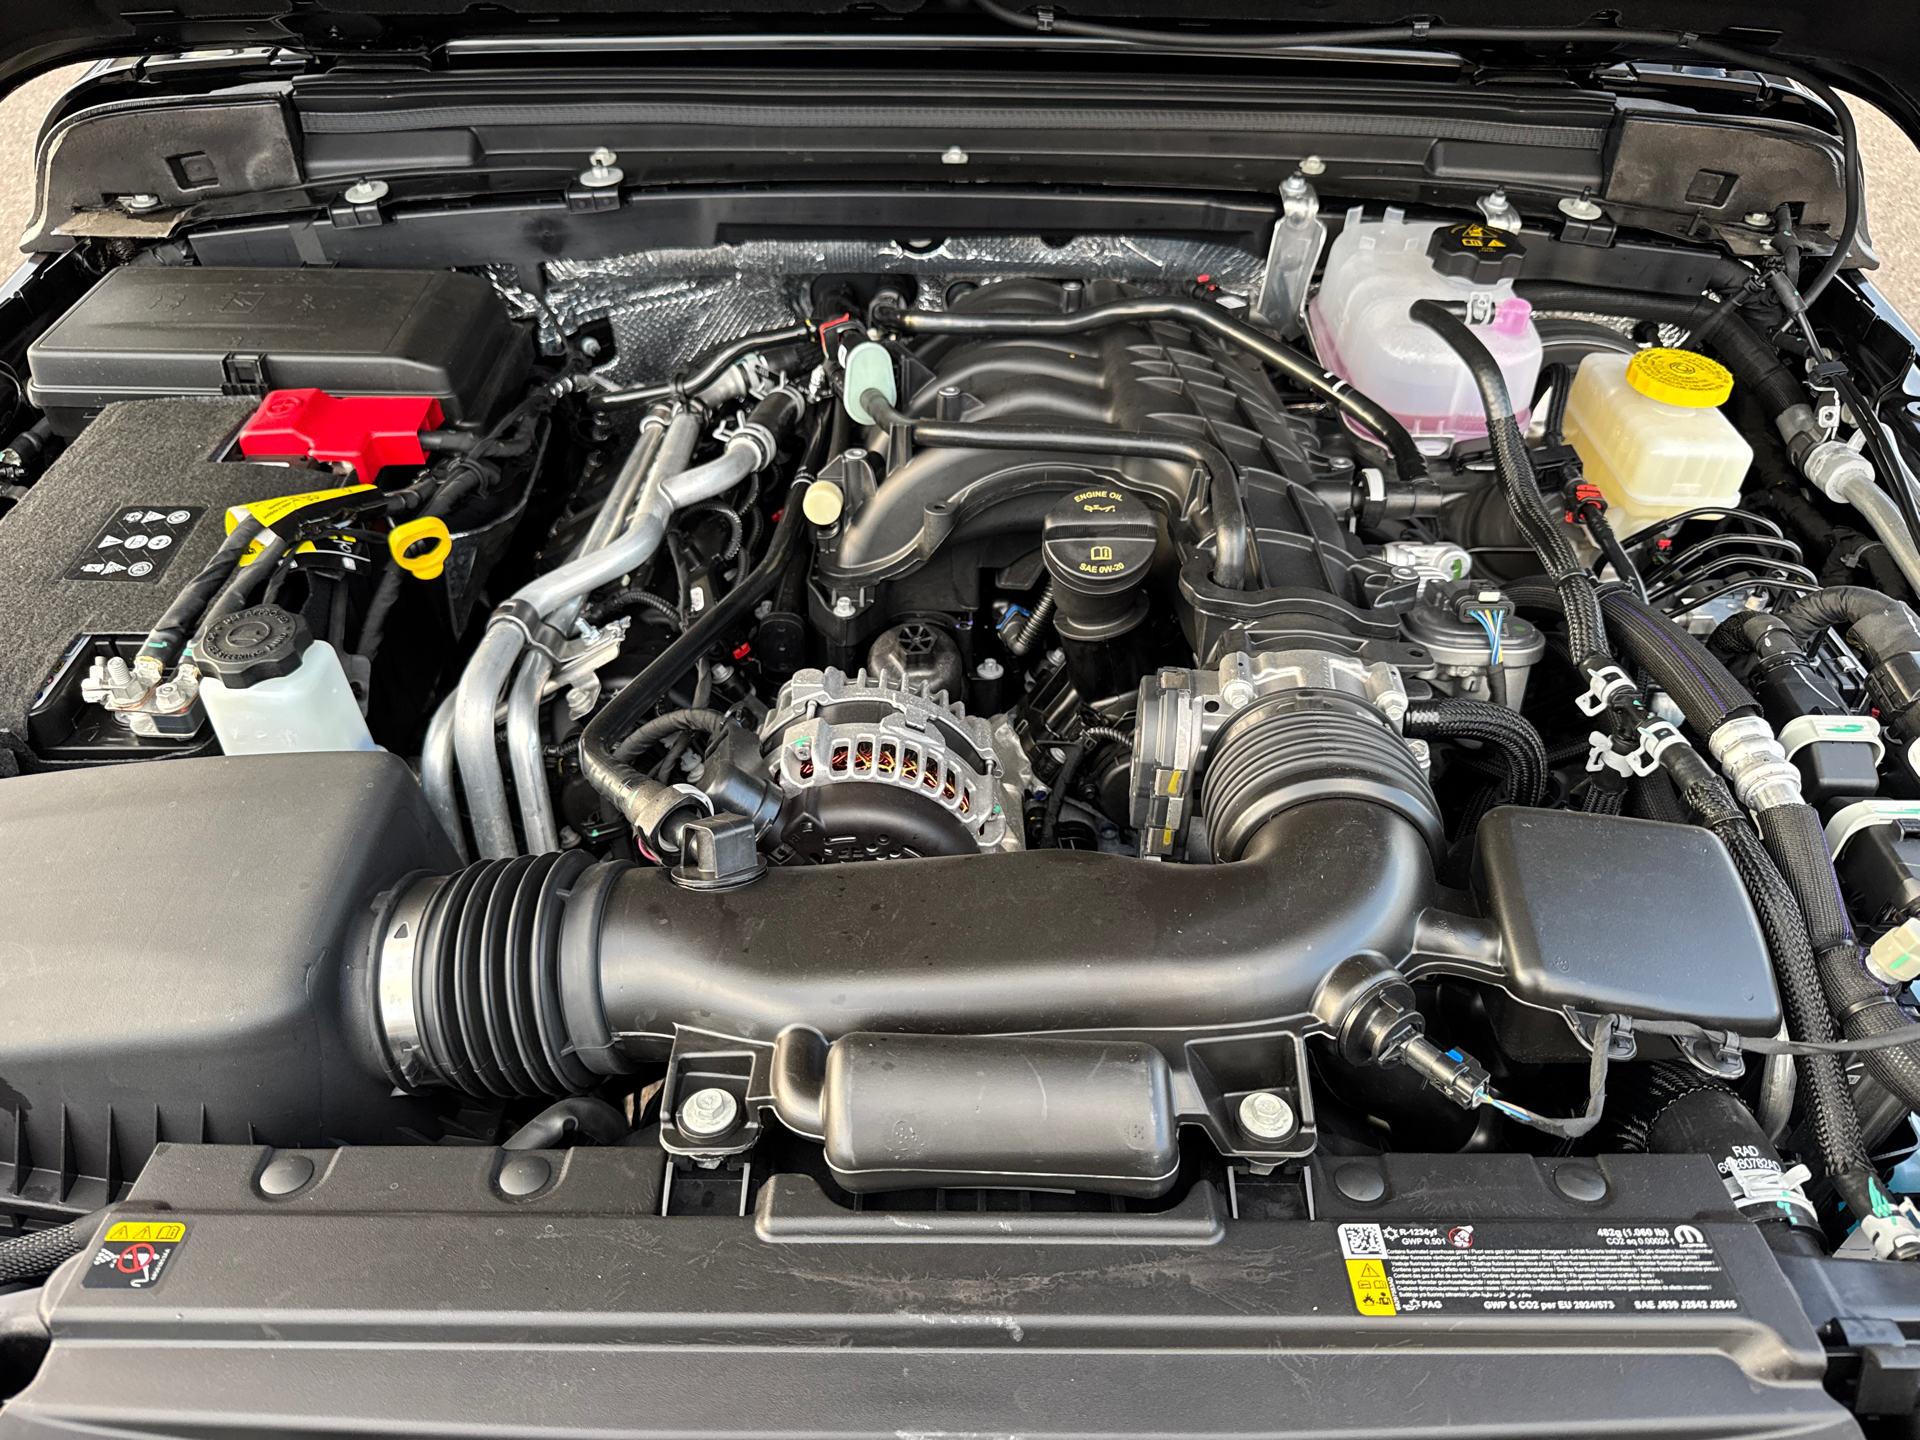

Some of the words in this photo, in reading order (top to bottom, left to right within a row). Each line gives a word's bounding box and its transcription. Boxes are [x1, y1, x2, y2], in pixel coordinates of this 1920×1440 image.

[1074, 491, 1108, 503] ENGINE
[1109, 492, 1123, 502] OIL
[1079, 563, 1098, 573] SAE
[1099, 562, 1125, 574] 0W-20
[245, 608, 289, 624] APPROVED
[1731, 1145, 1759, 1157] RAD
[1399, 1228, 1438, 1237] R-1234yf
[1597, 1228, 1622, 1238] 482g
[1654, 1228, 1670, 1238] lb)
[1401, 1238, 1423, 1246] GWP
[1424, 1238, 1447, 1246] 0.501
[1605, 1237, 1625, 1246] CO2
[1626, 1239, 1638, 1247] eq
[1638, 1237, 1670, 1246] 0.00024
[1422, 1301, 1443, 1310] PAG
[1484, 1301, 1508, 1310] GWP
[1510, 1301, 1517, 1310] &
[1518, 1301, 1539, 1310] CO2
[1540, 1303, 1556, 1311] per
[1558, 1301, 1572, 1310] EU
[1574, 1301, 1615, 1310] 2024/573
[1633, 1301, 1656, 1310] SAE
[1657, 1301, 1680, 1310] J639
